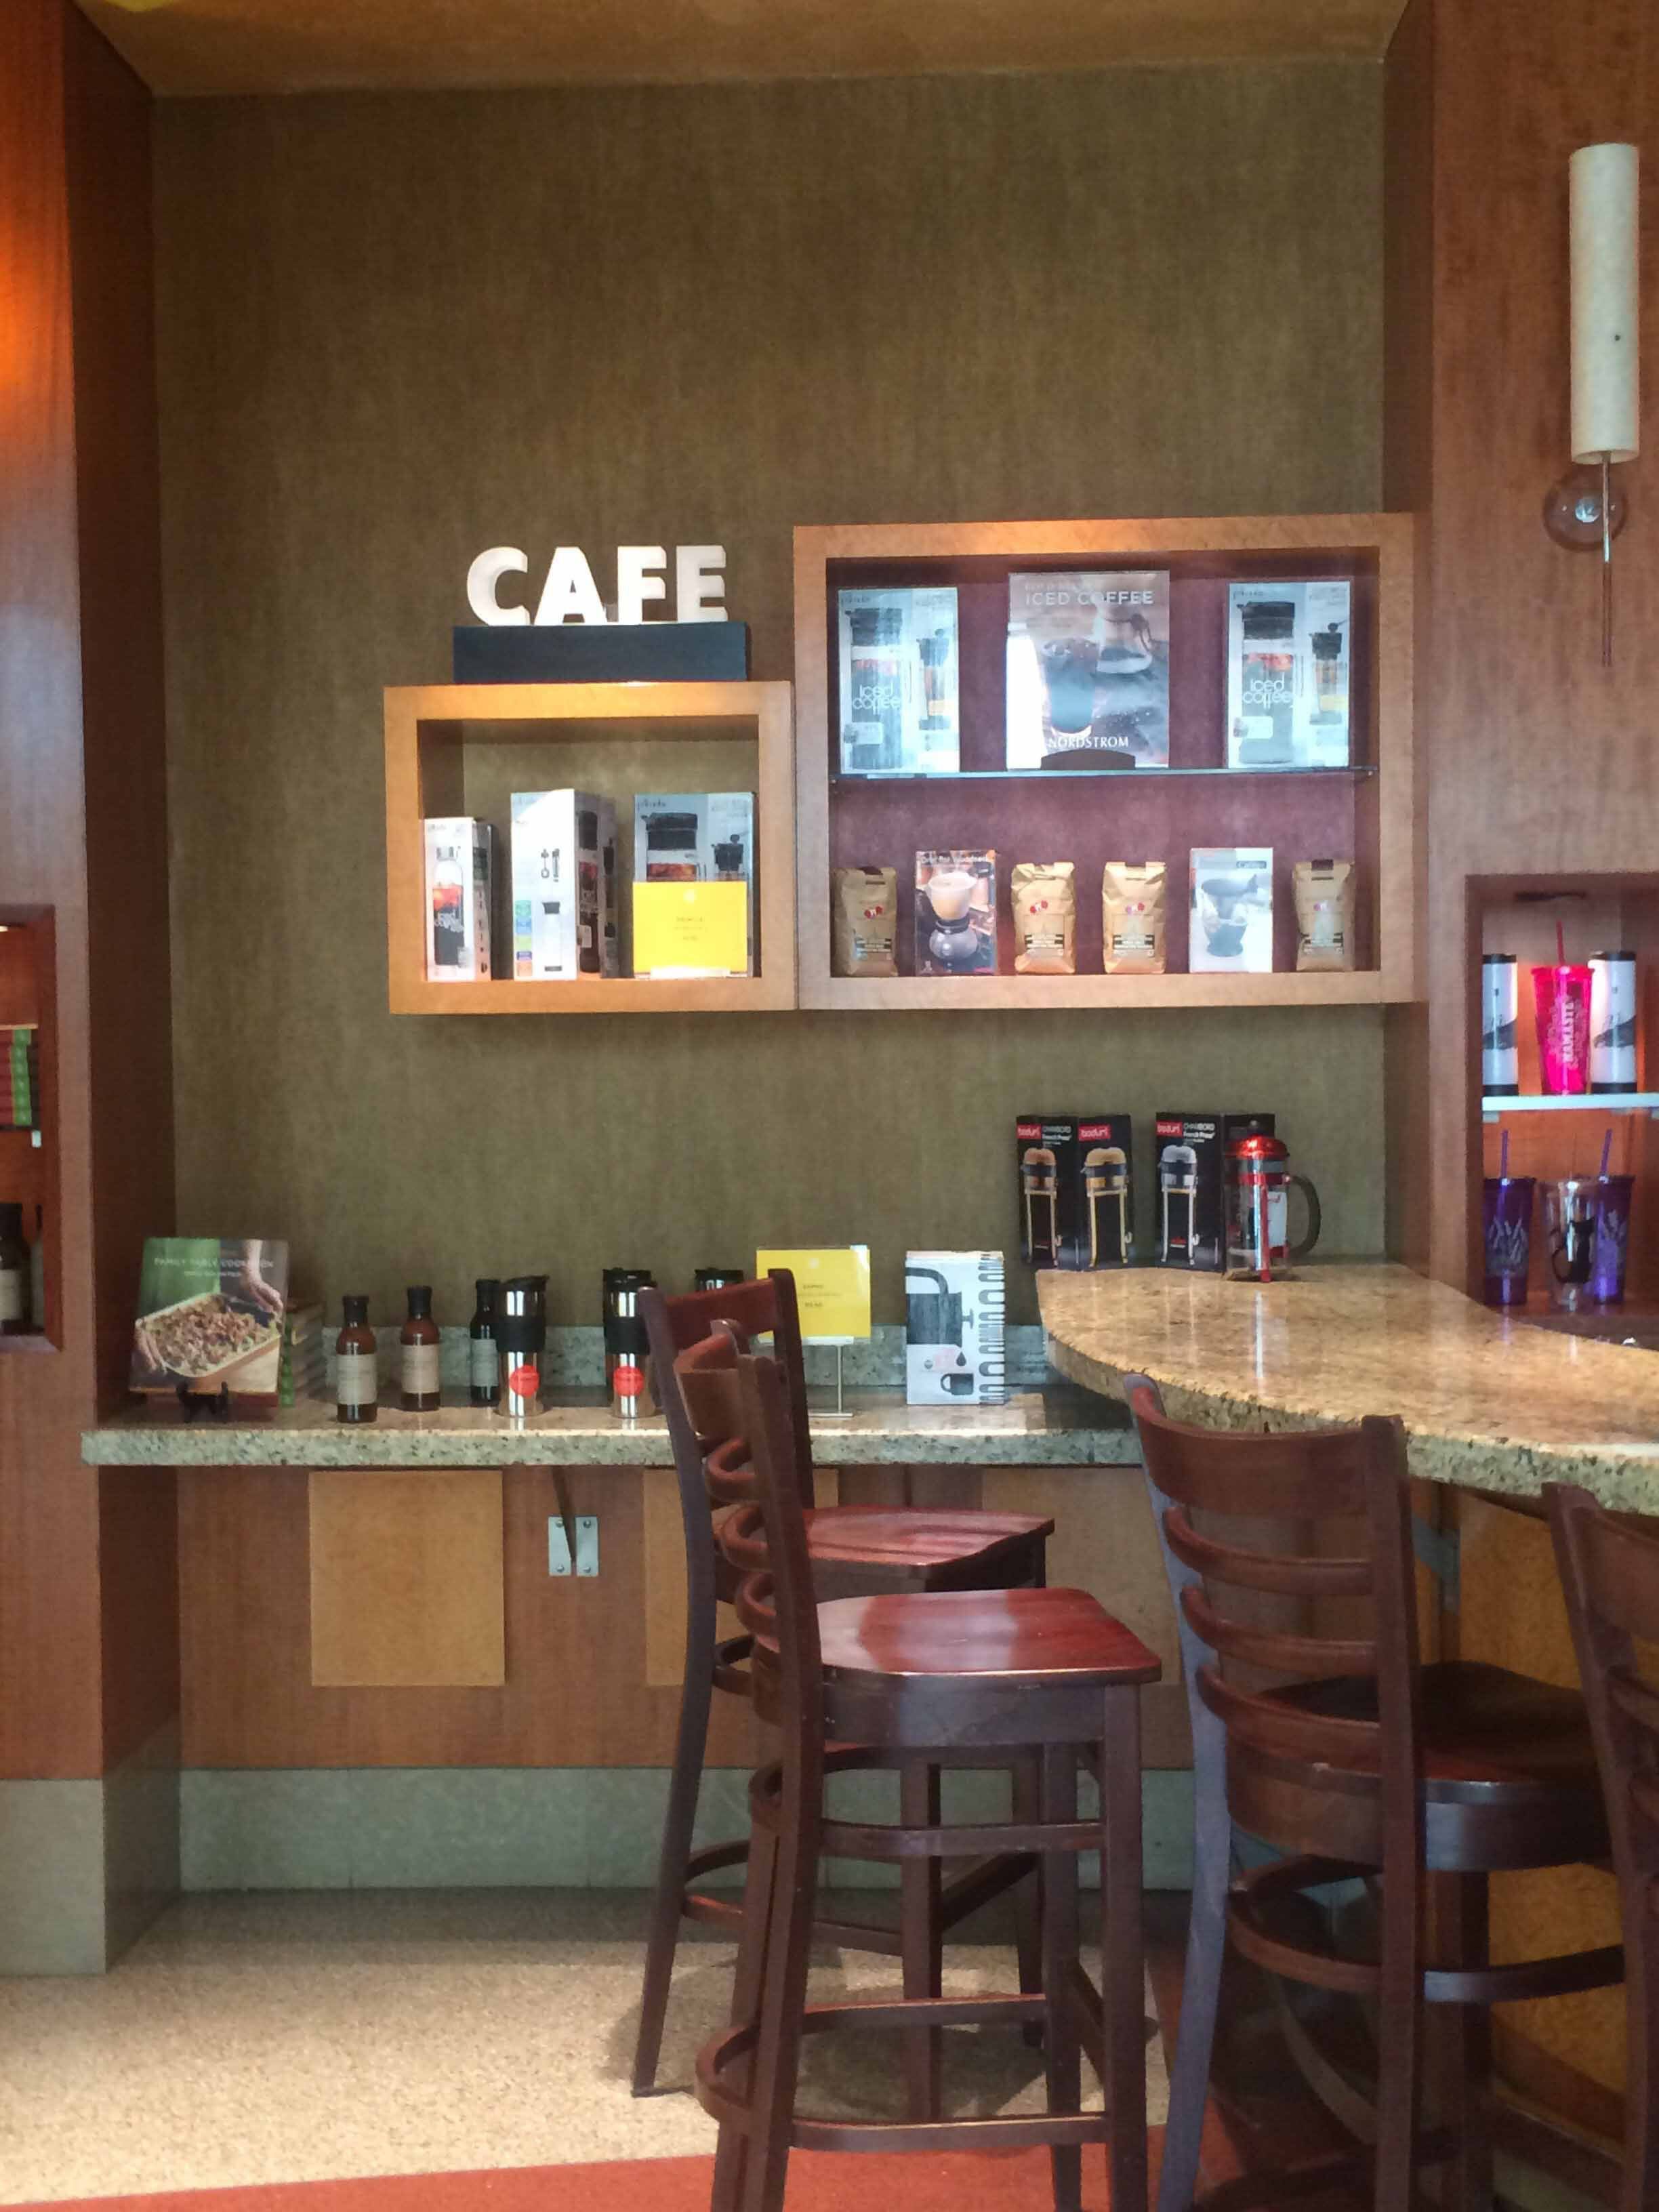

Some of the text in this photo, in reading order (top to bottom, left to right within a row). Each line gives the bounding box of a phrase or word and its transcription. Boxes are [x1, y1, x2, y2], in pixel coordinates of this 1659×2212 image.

[466, 545, 729, 627] CAFE
[1025, 590, 1154, 605] ICED COFFEE
[852, 695, 901, 716] coffee
[1243, 690, 1292, 710] coffee
[1048, 736, 1129, 748] NORDSTROM
[1561, 999, 1574, 1063] NAMASTE
